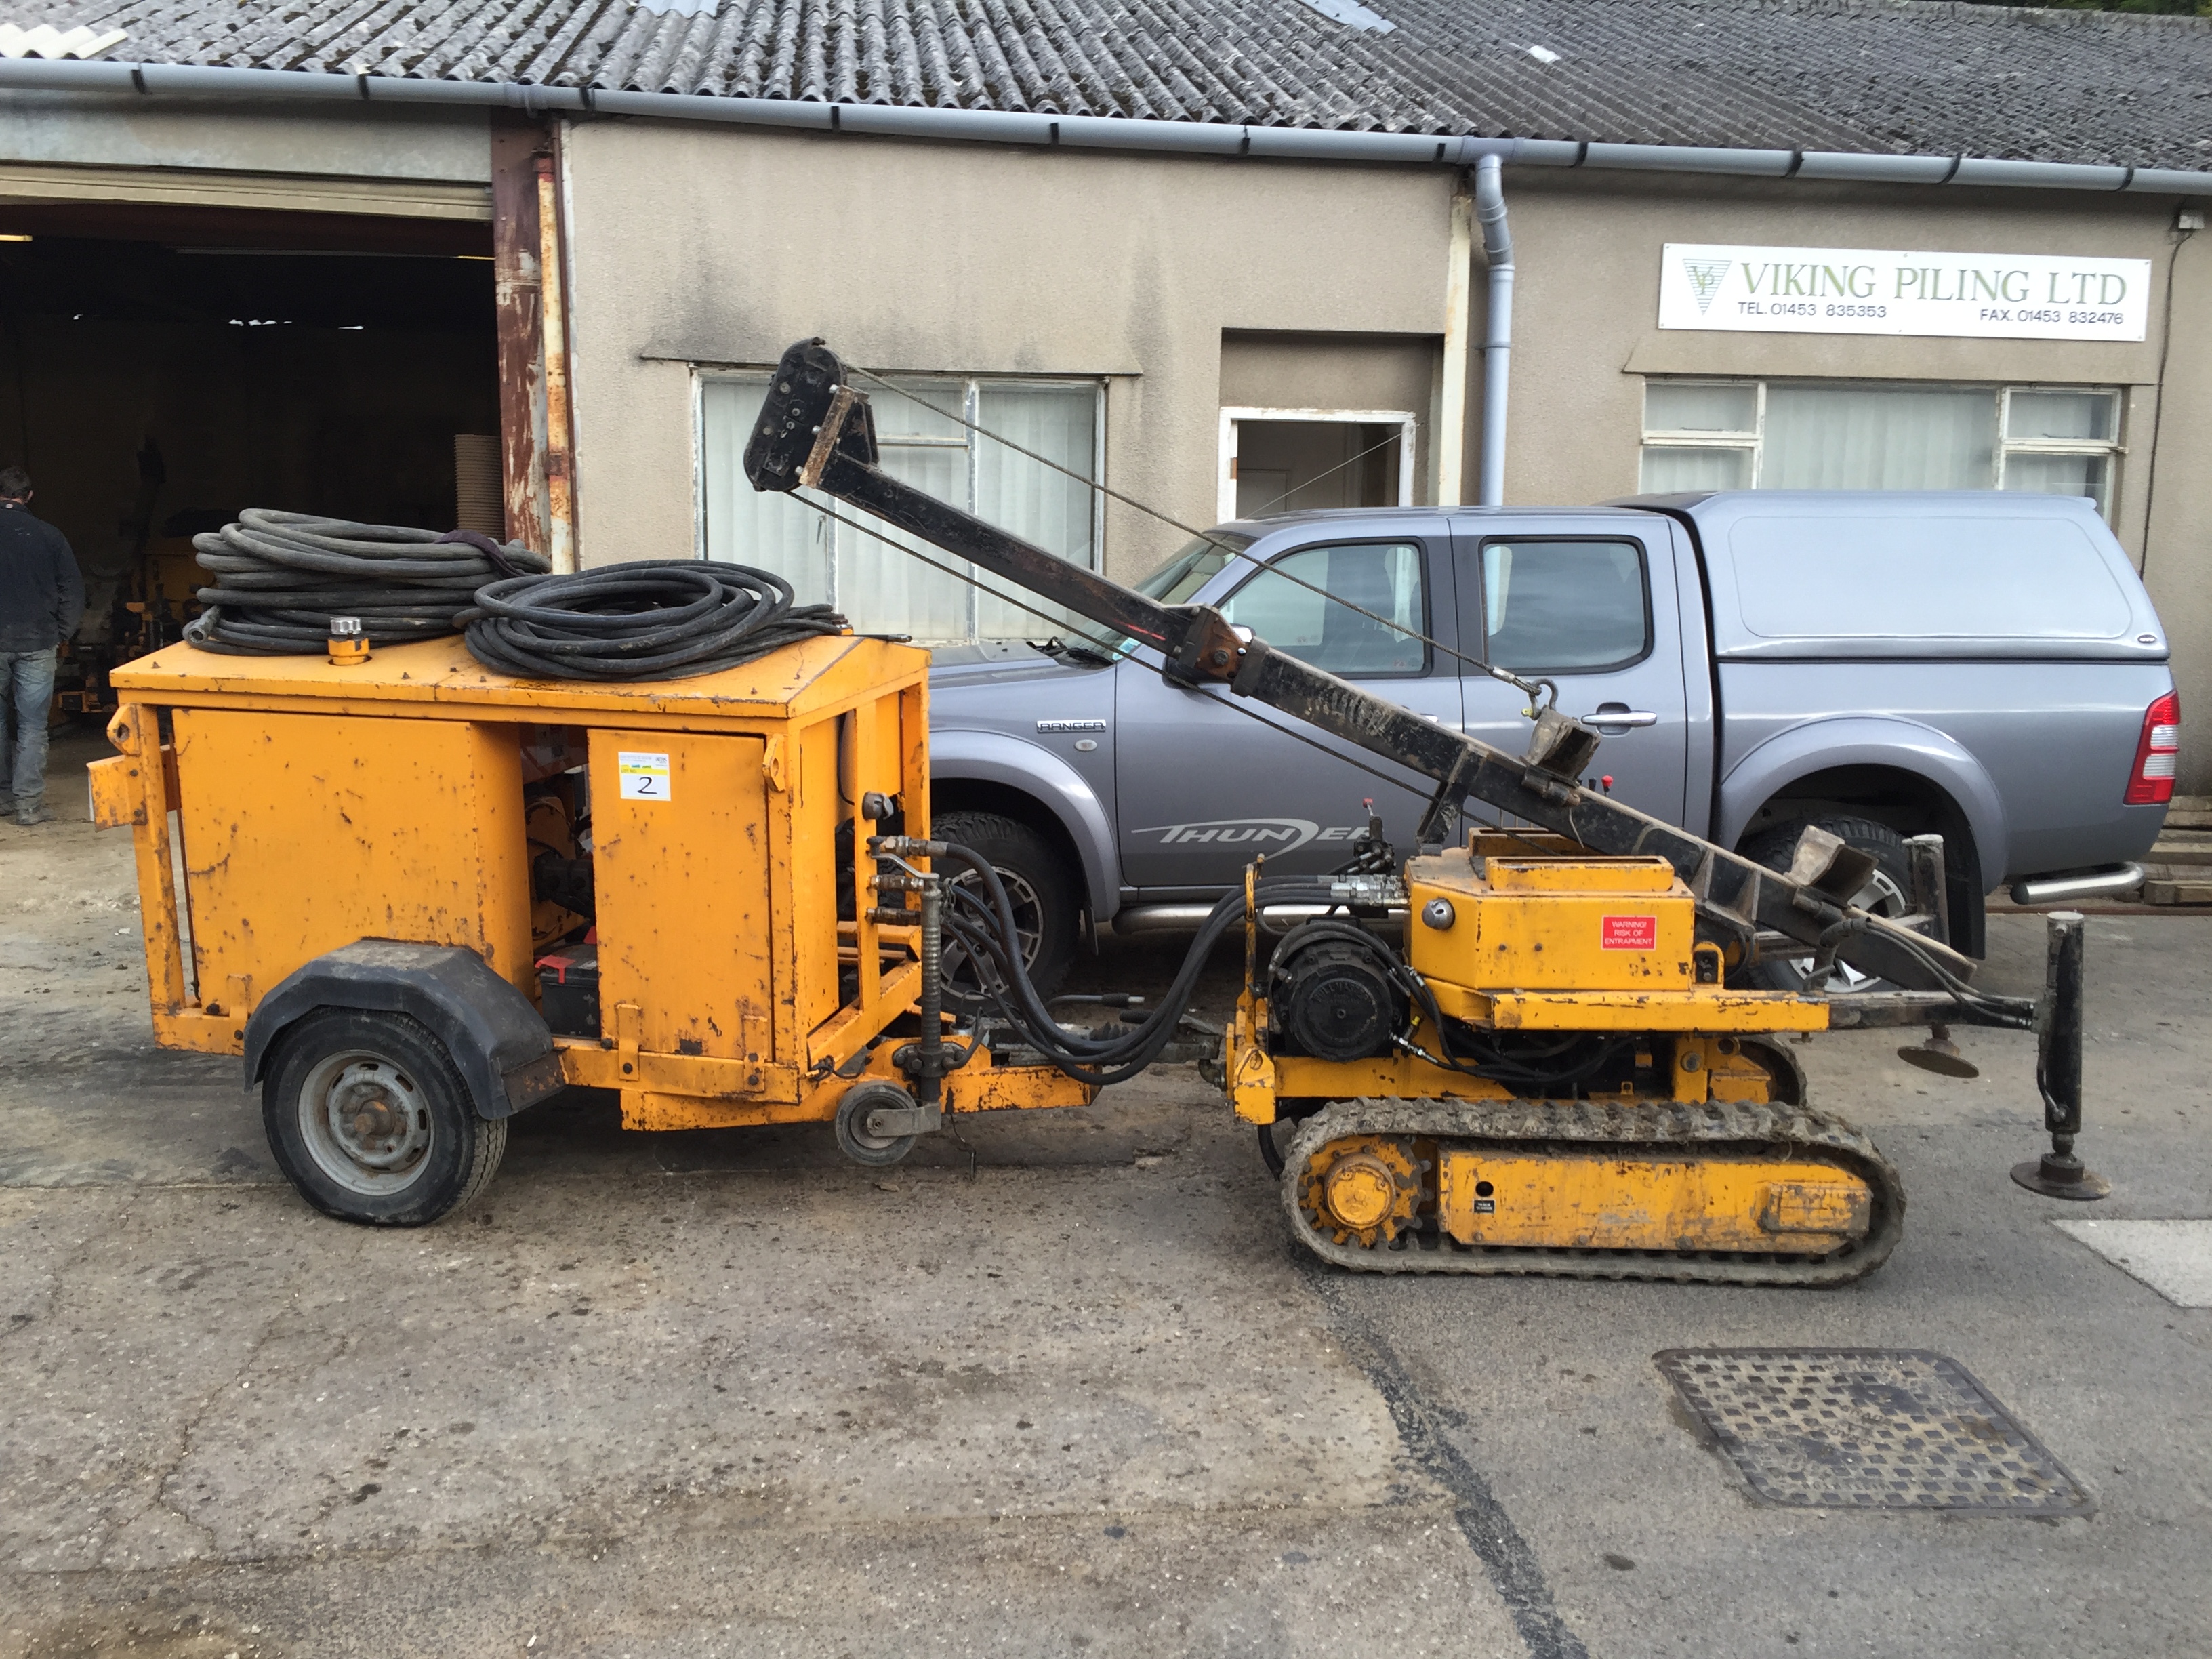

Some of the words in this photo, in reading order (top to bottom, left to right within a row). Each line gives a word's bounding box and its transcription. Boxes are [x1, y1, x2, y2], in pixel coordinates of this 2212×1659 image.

[1740, 262, 1877, 298] VIKING
[1893, 267, 2030, 302] PILING
[2046, 271, 2127, 306] LTD
[1770, 303, 1817, 316] 01453
[1826, 304, 1888, 319] 835353
[2017, 310, 2062, 323] 01453
[2068, 311, 2125, 325] 832476
[1040, 722, 1105, 731] RANGER
[637, 776, 658, 795] 2
